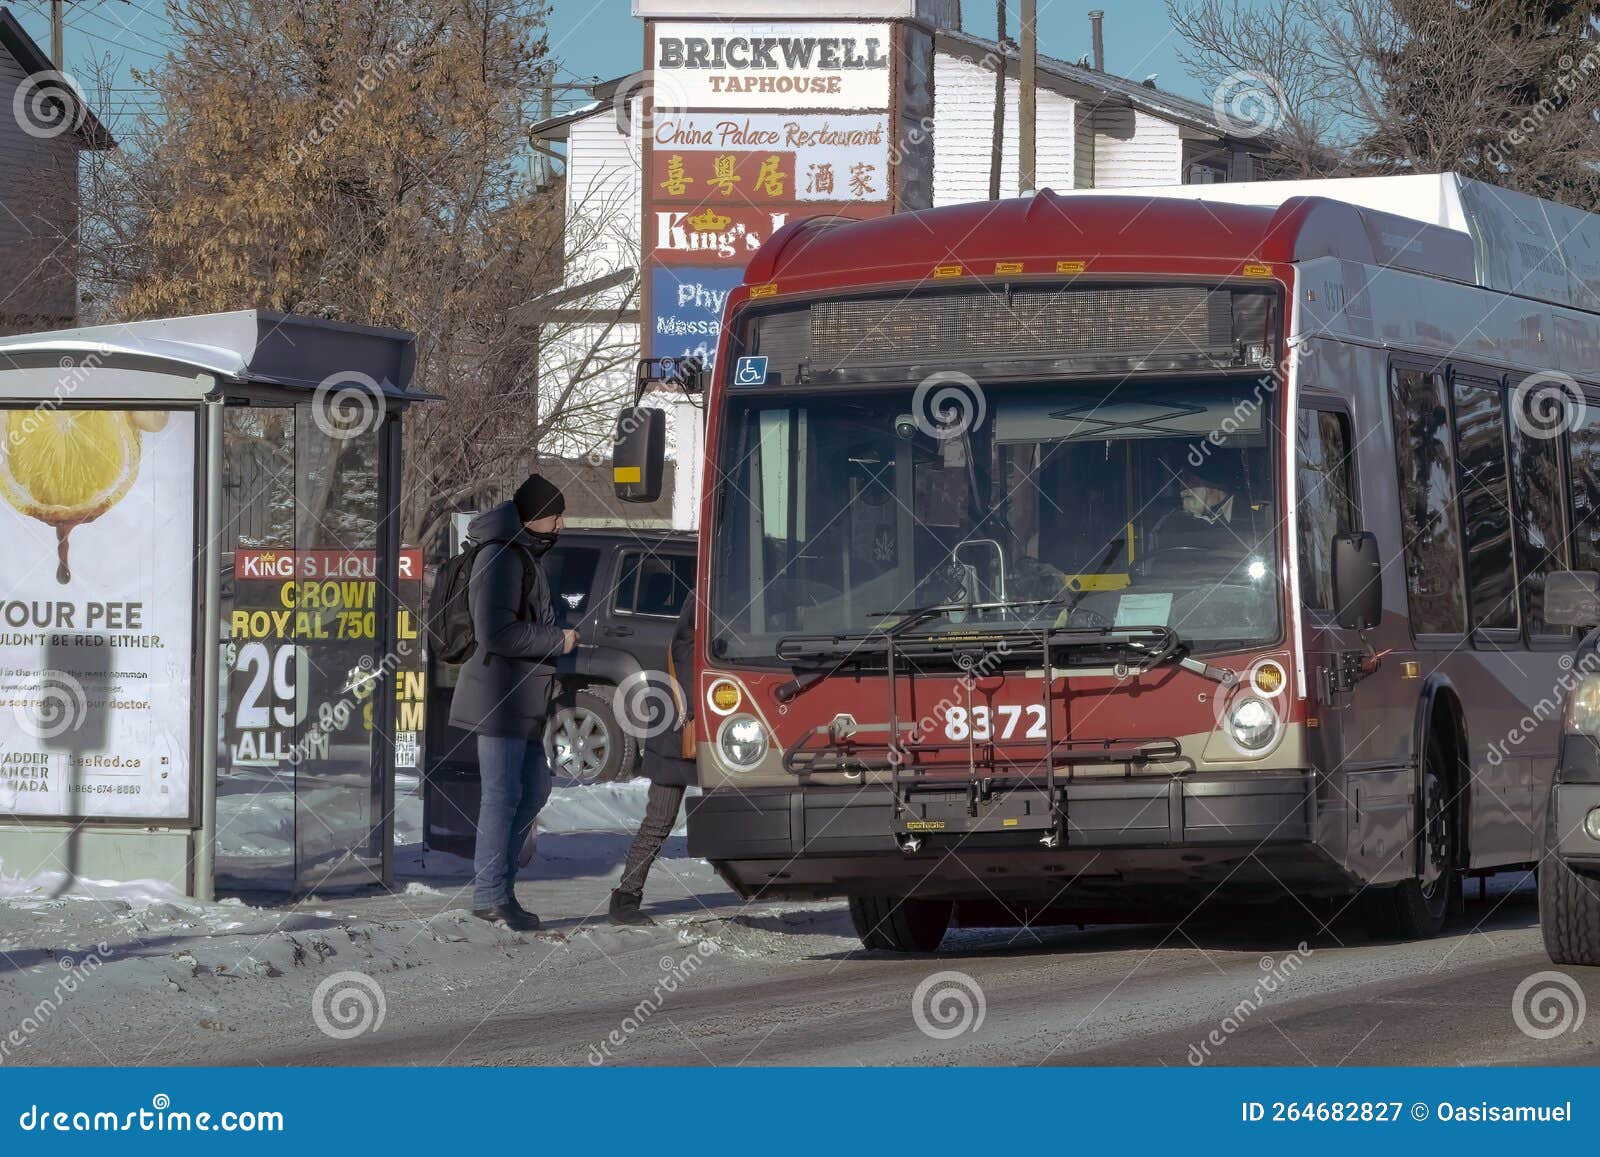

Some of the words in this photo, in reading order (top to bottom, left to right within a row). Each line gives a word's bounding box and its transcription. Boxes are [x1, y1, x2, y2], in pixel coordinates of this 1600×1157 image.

[659, 37, 887, 70] BRICKWELL
[709, 76, 842, 93] TAPHOUSE
[655, 120, 713, 145] China
[716, 119, 779, 147] Palace
[783, 121, 884, 147] Restaurant
[655, 211, 761, 258] King's
[678, 283, 726, 313] Phy
[656, 316, 720, 336] Massa
[325, 557, 412, 577] LIQUR
[86, 602, 143, 629] PEE
[231, 611, 328, 638] ROYAL
[52, 635, 69, 646] BE
[75, 635, 103, 647] RED
[110, 635, 164, 648] EITHER.
[945, 704, 1047, 741] 8372
[1, 752, 49, 765] ADDER
[0, 767, 49, 779] ANCER
